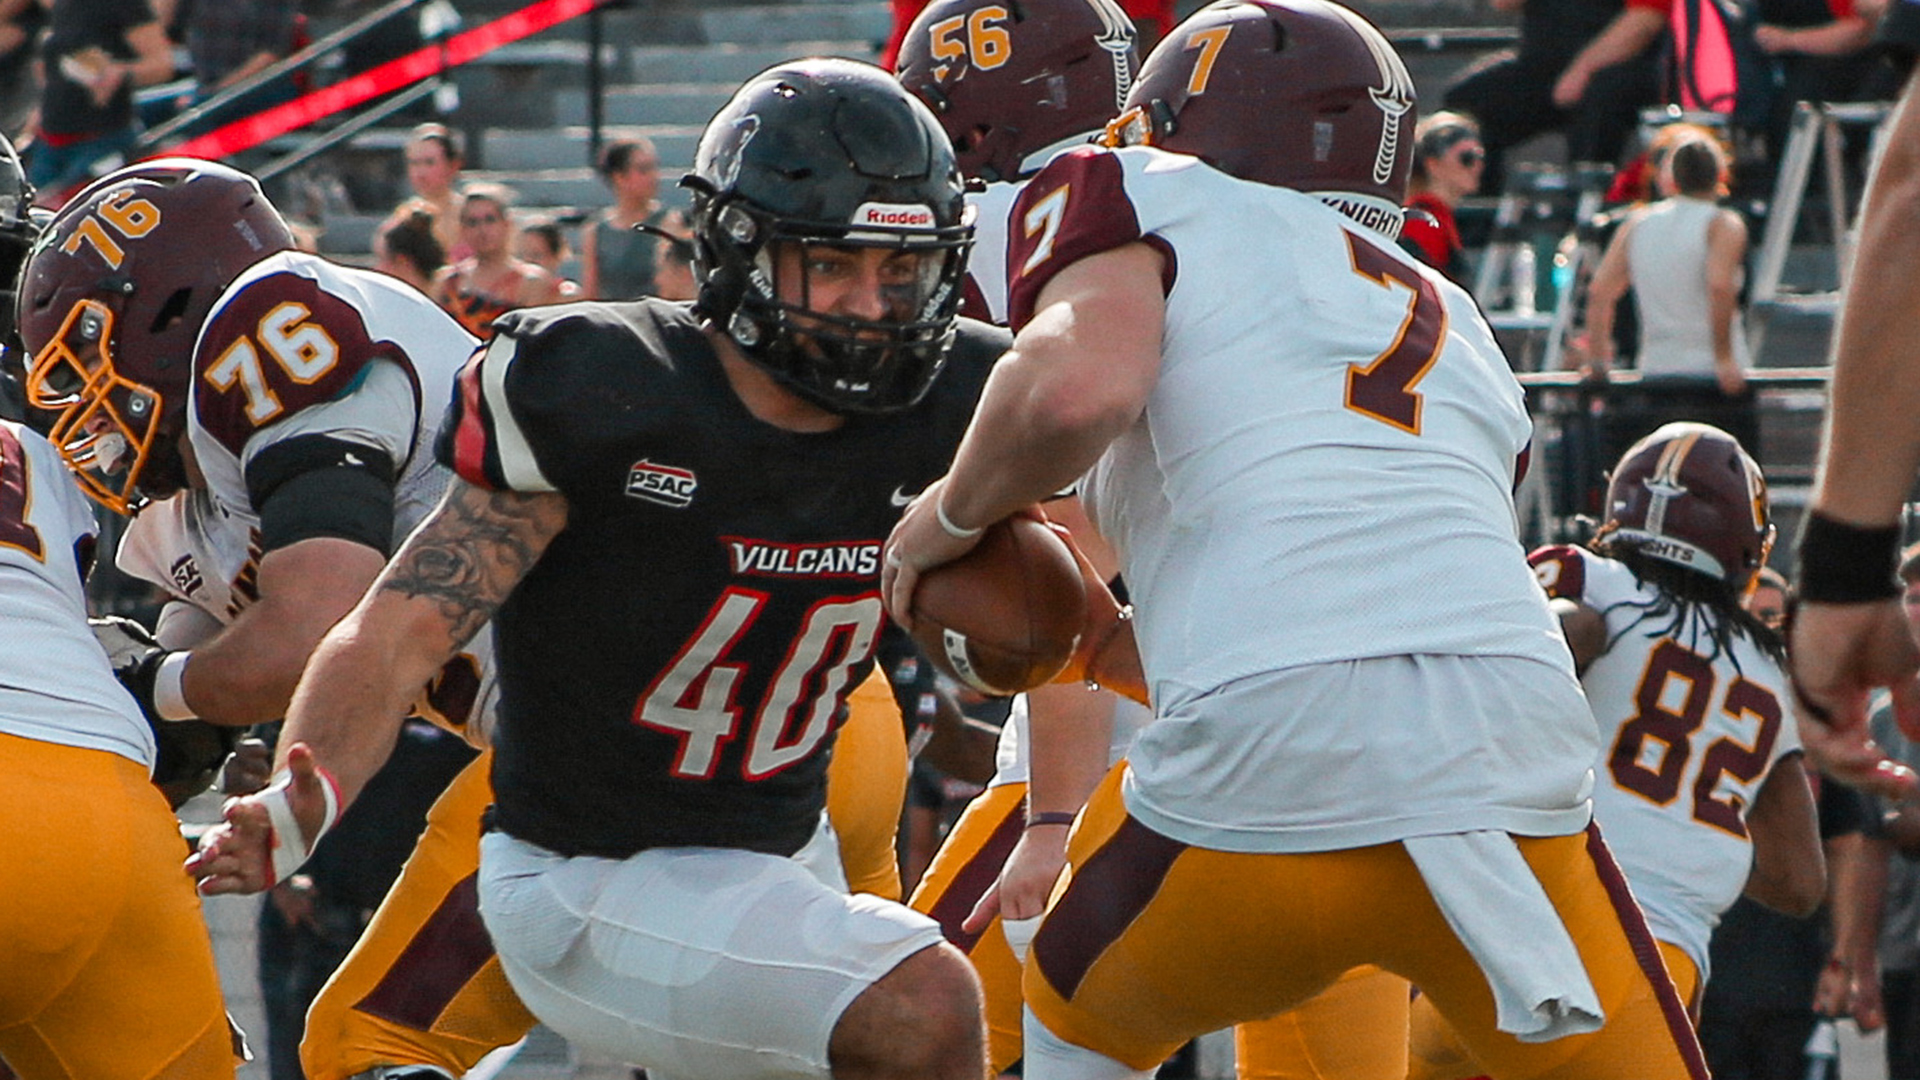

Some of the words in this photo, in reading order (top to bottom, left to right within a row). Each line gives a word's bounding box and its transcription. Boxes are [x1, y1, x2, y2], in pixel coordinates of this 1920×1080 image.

[929, 5, 1011, 83] 56
[1183, 25, 1233, 95] 7
[59, 188, 161, 271] 76
[1022, 184, 1070, 276] 7
[1321, 198, 1400, 236] NIGHT
[203, 301, 340, 427] 76
[1340, 225, 1449, 436] 7
[628, 471, 698, 498] PSAC
[731, 542, 881, 575] VULCANS
[631, 585, 887, 783] 40
[1606, 637, 1783, 842] 82
